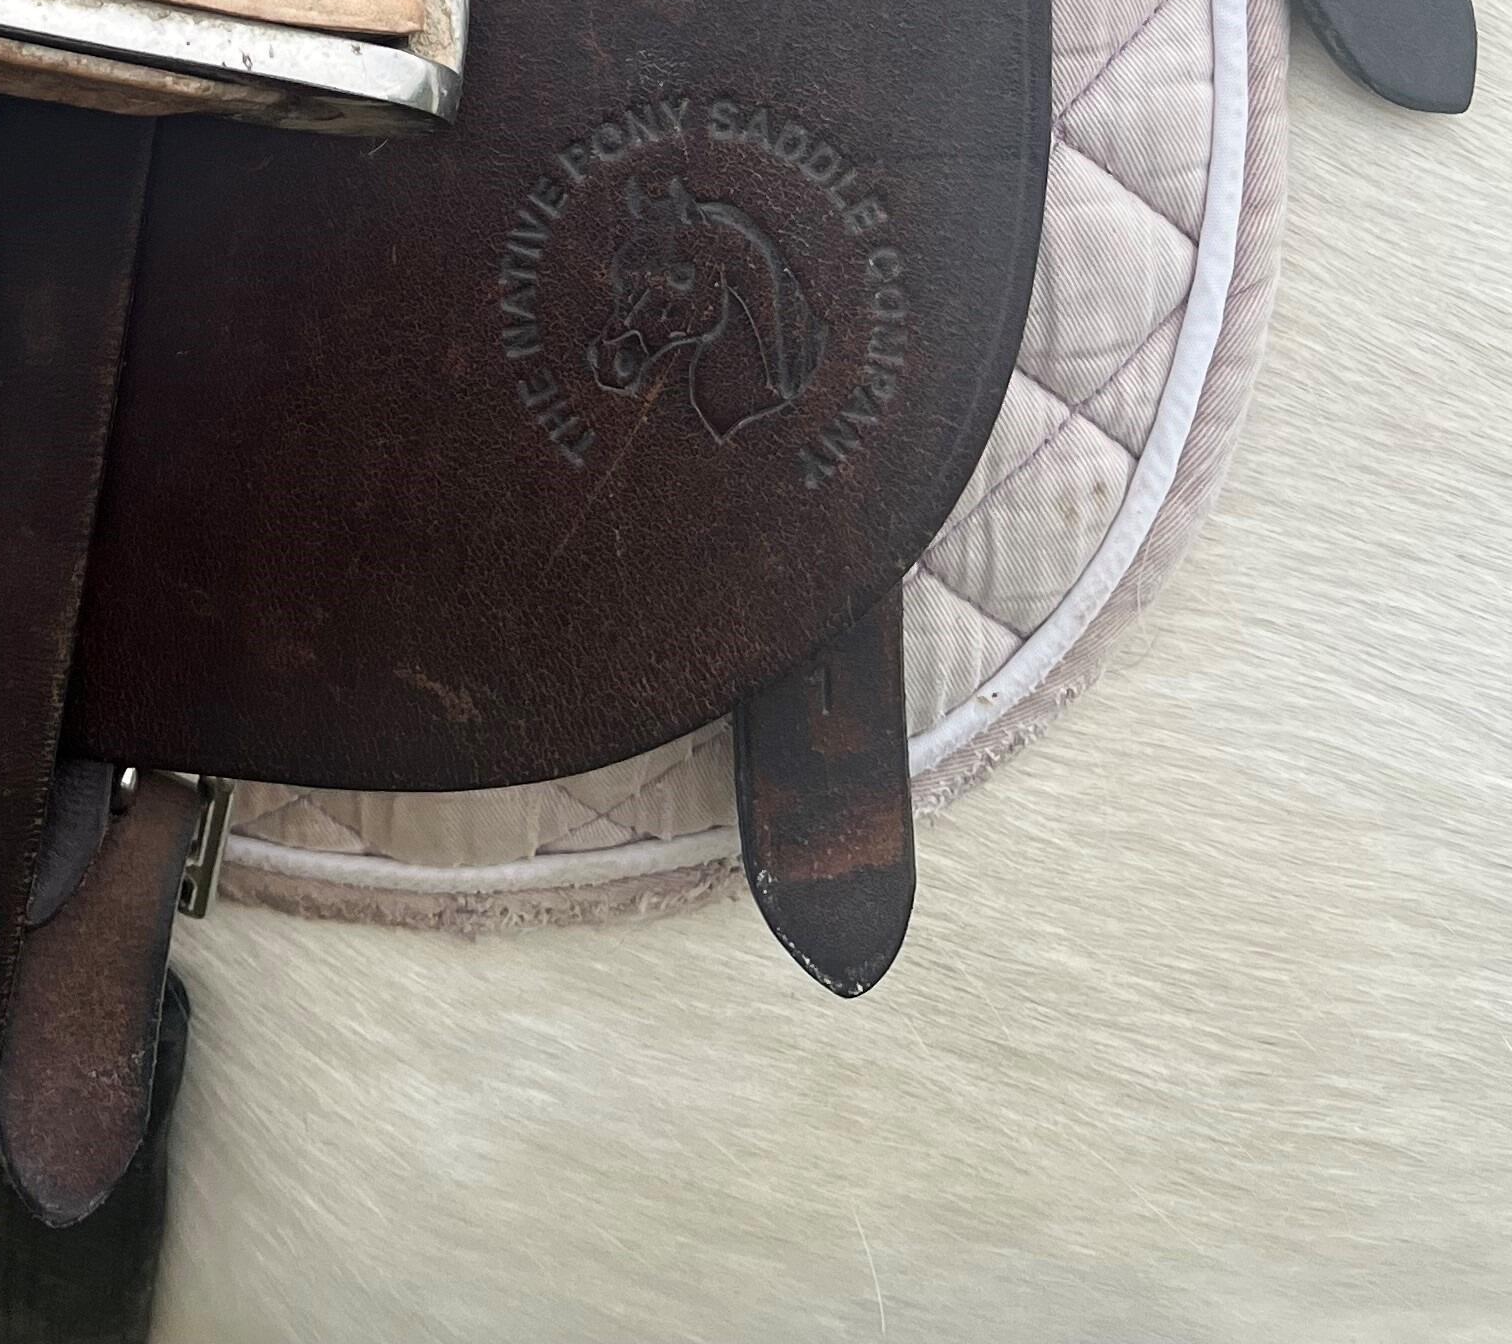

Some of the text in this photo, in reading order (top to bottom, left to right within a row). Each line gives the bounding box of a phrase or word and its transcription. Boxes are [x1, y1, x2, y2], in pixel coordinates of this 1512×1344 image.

[499, 97, 908, 489] THE NATIVE PONY SADDLE COMPANY
